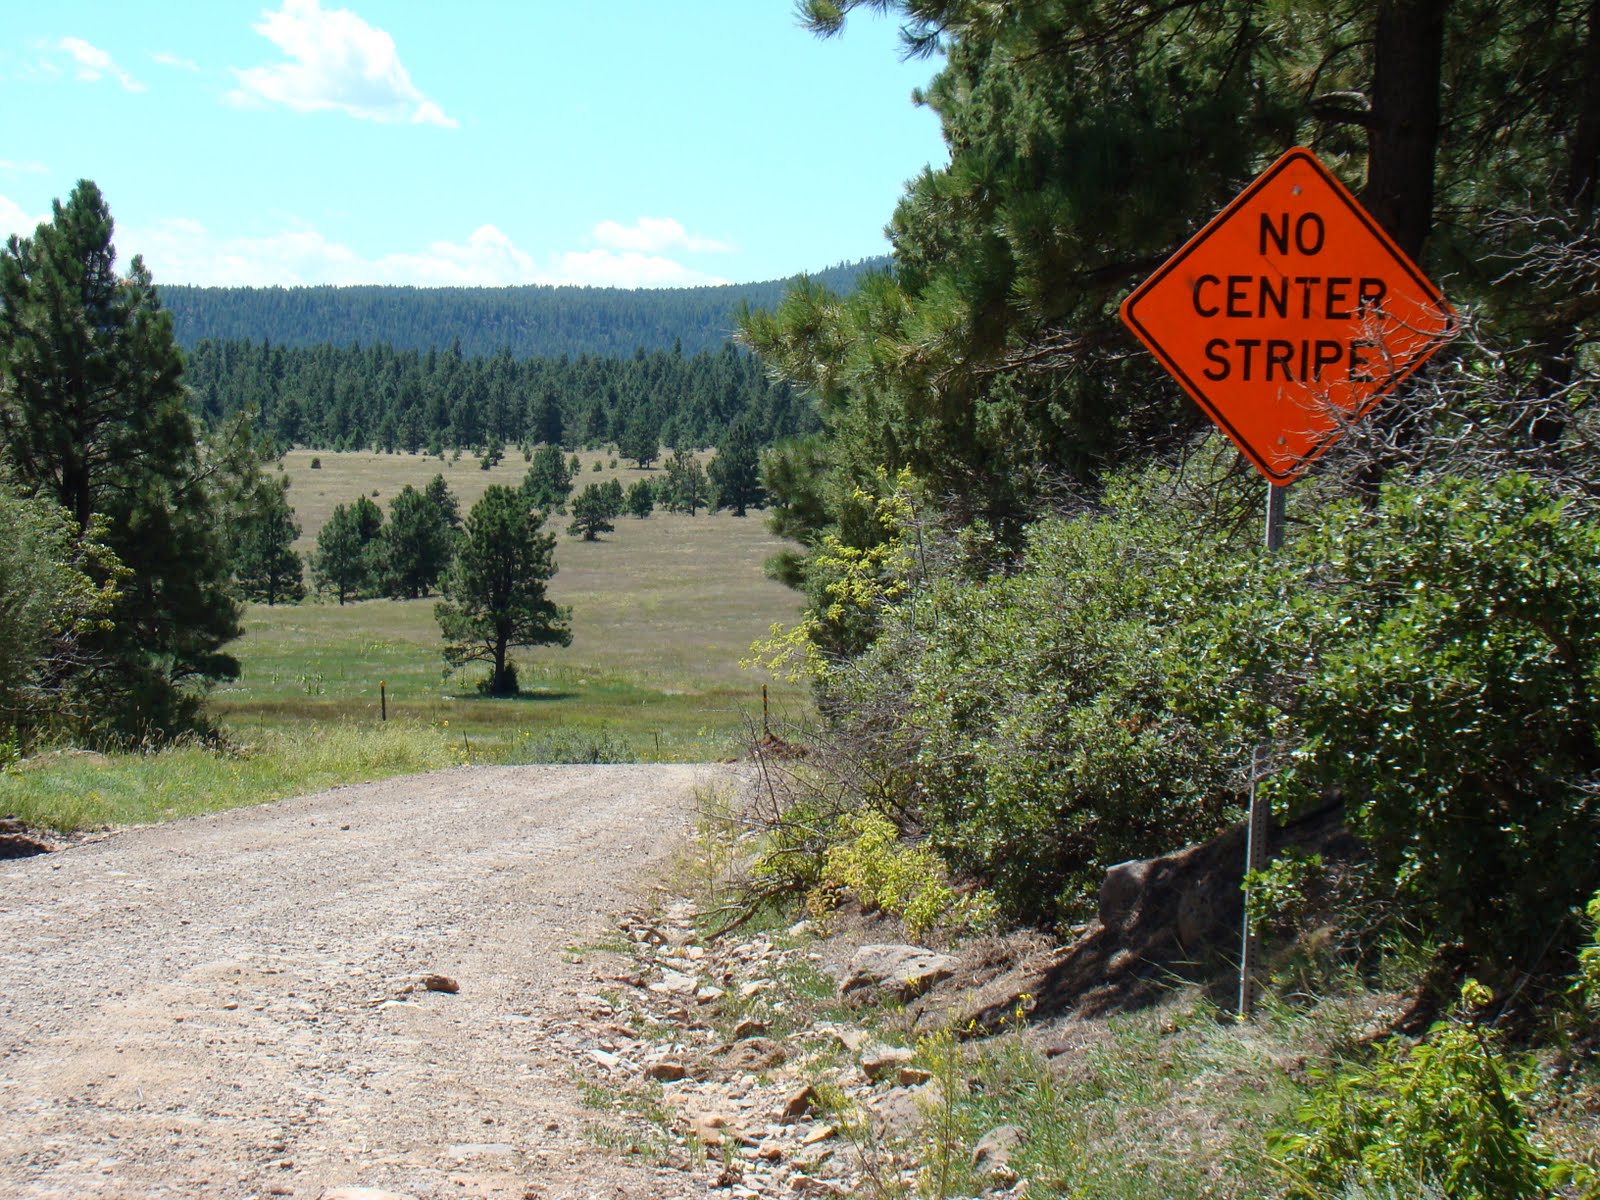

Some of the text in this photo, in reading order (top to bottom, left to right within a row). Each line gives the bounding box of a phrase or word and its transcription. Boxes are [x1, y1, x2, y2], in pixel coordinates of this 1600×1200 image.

[1259, 212, 1325, 256] NO
[1192, 274, 1388, 320] CENTER
[1202, 338, 1375, 383] STRIPE
